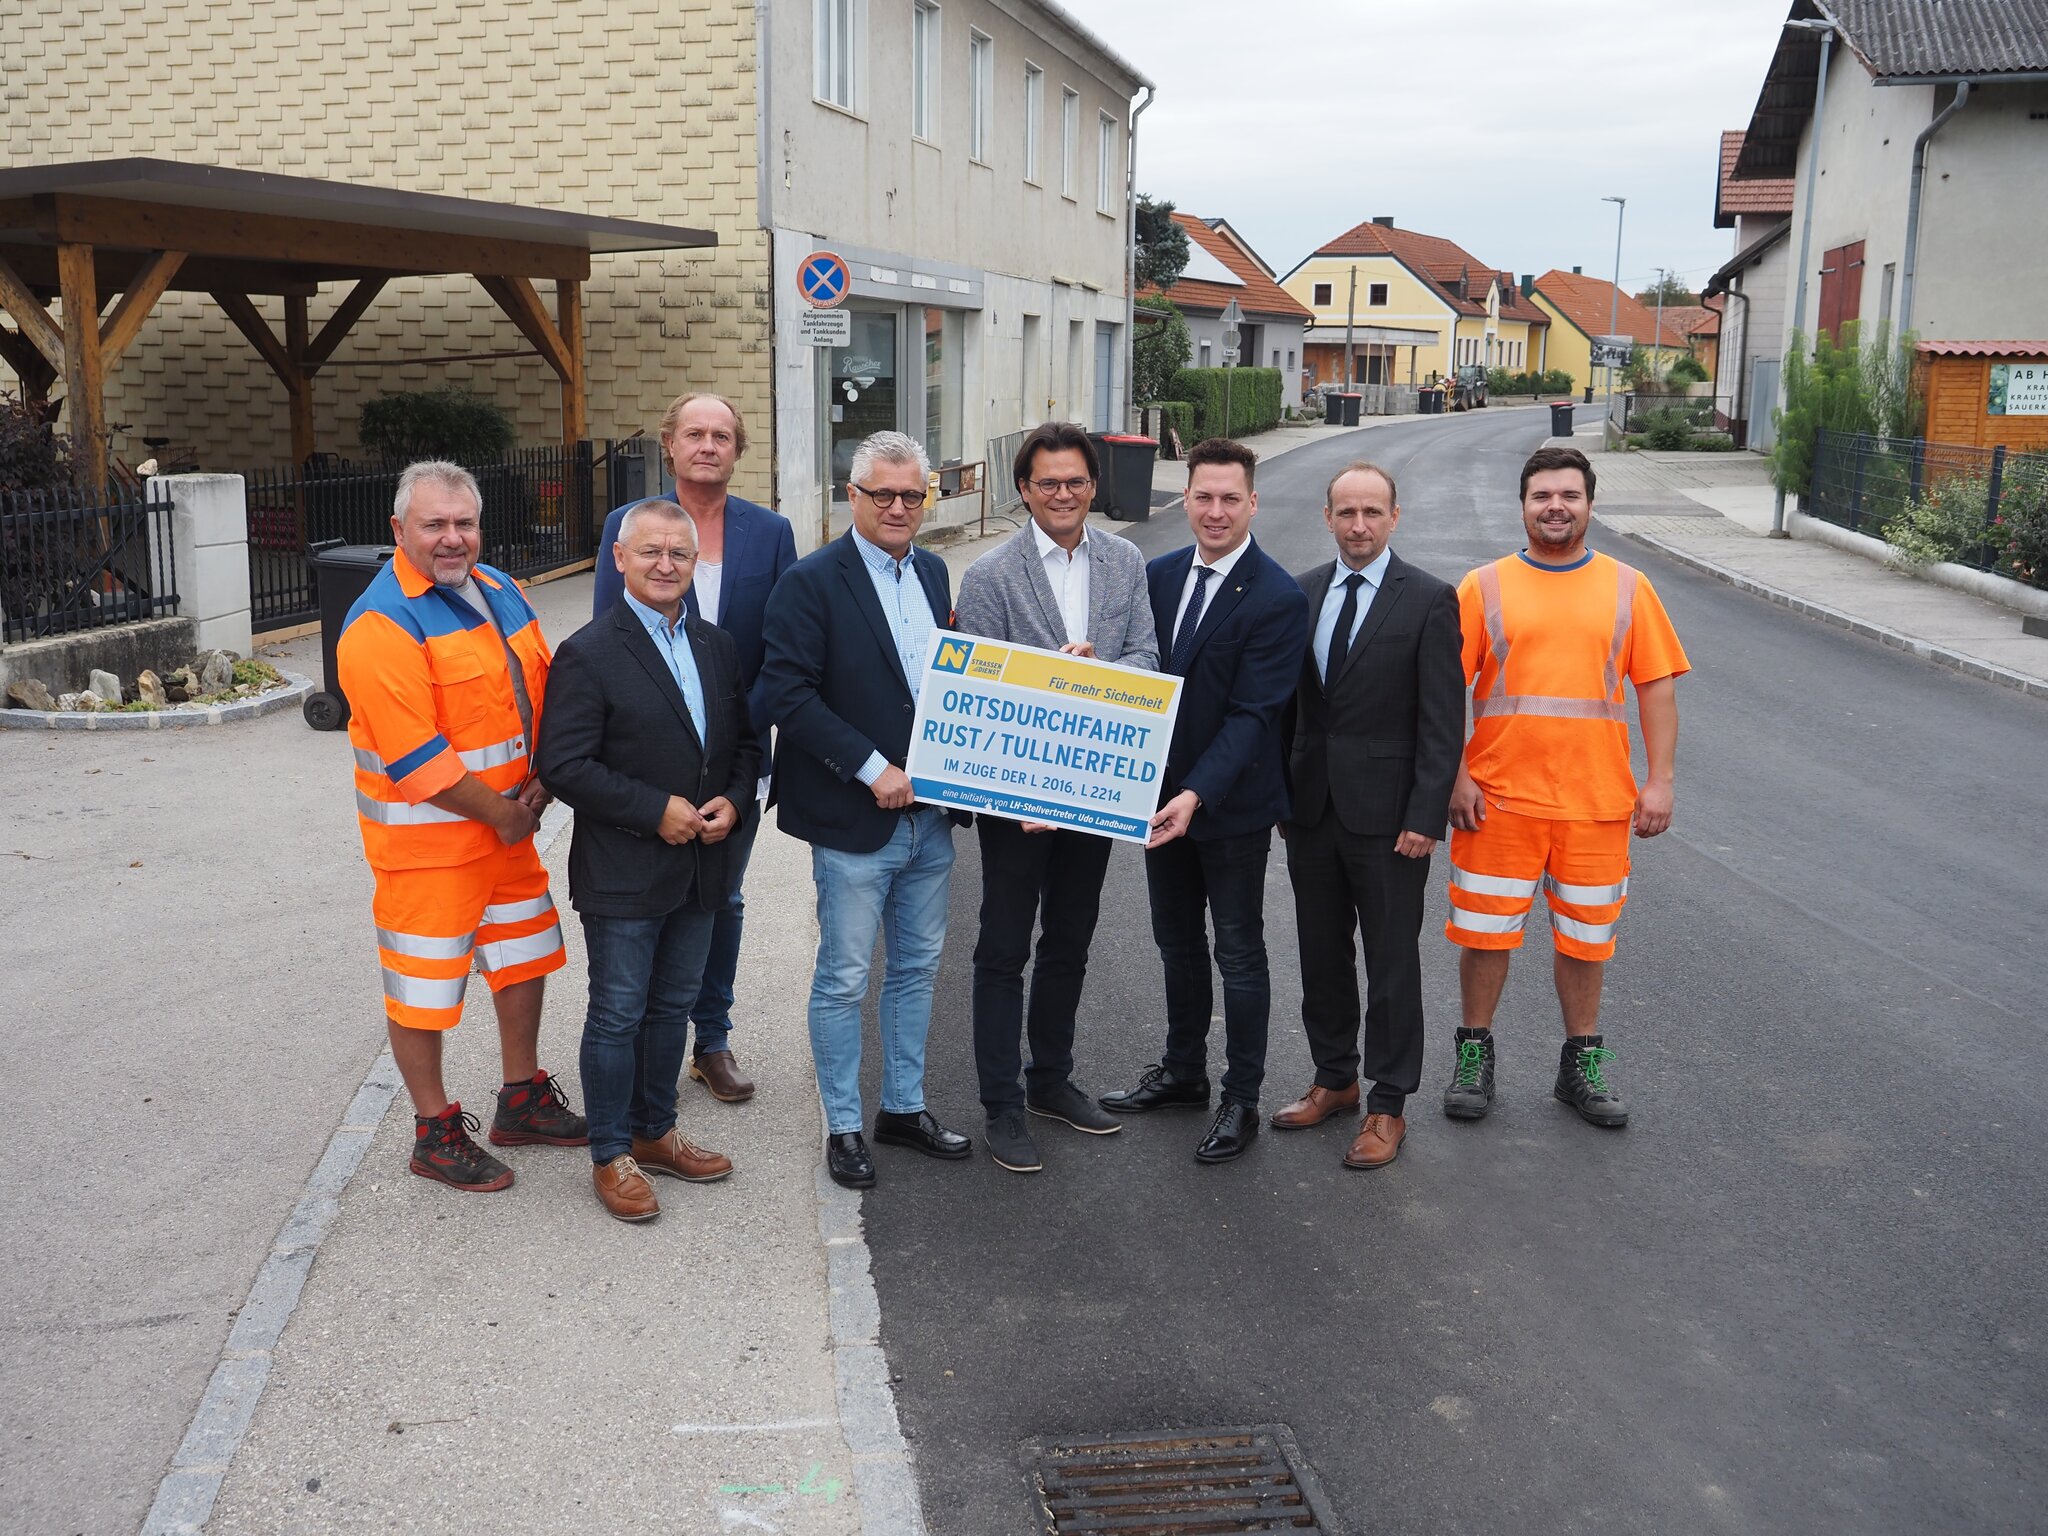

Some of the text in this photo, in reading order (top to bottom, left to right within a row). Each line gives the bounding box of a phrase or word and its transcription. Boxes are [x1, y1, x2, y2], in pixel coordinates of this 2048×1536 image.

[803, 320, 844, 328] Tankfahrzeuge
[2014, 370, 2034, 380] AB
[971, 658, 1003, 669] STRASSEN
[1049, 677, 1163, 709] Für mehr Sicherheit
[943, 690, 1151, 749] ORTSDURCHFAHRT
[923, 719, 982, 749] RUST
[1001, 733, 1156, 783] TULLNERFELD
[944, 758, 1121, 803] IM ZUGE DER L 2016, L 2214
[942, 789, 1138, 832] eine Initiative von LH-Stellvertreter Udo Landbauer
